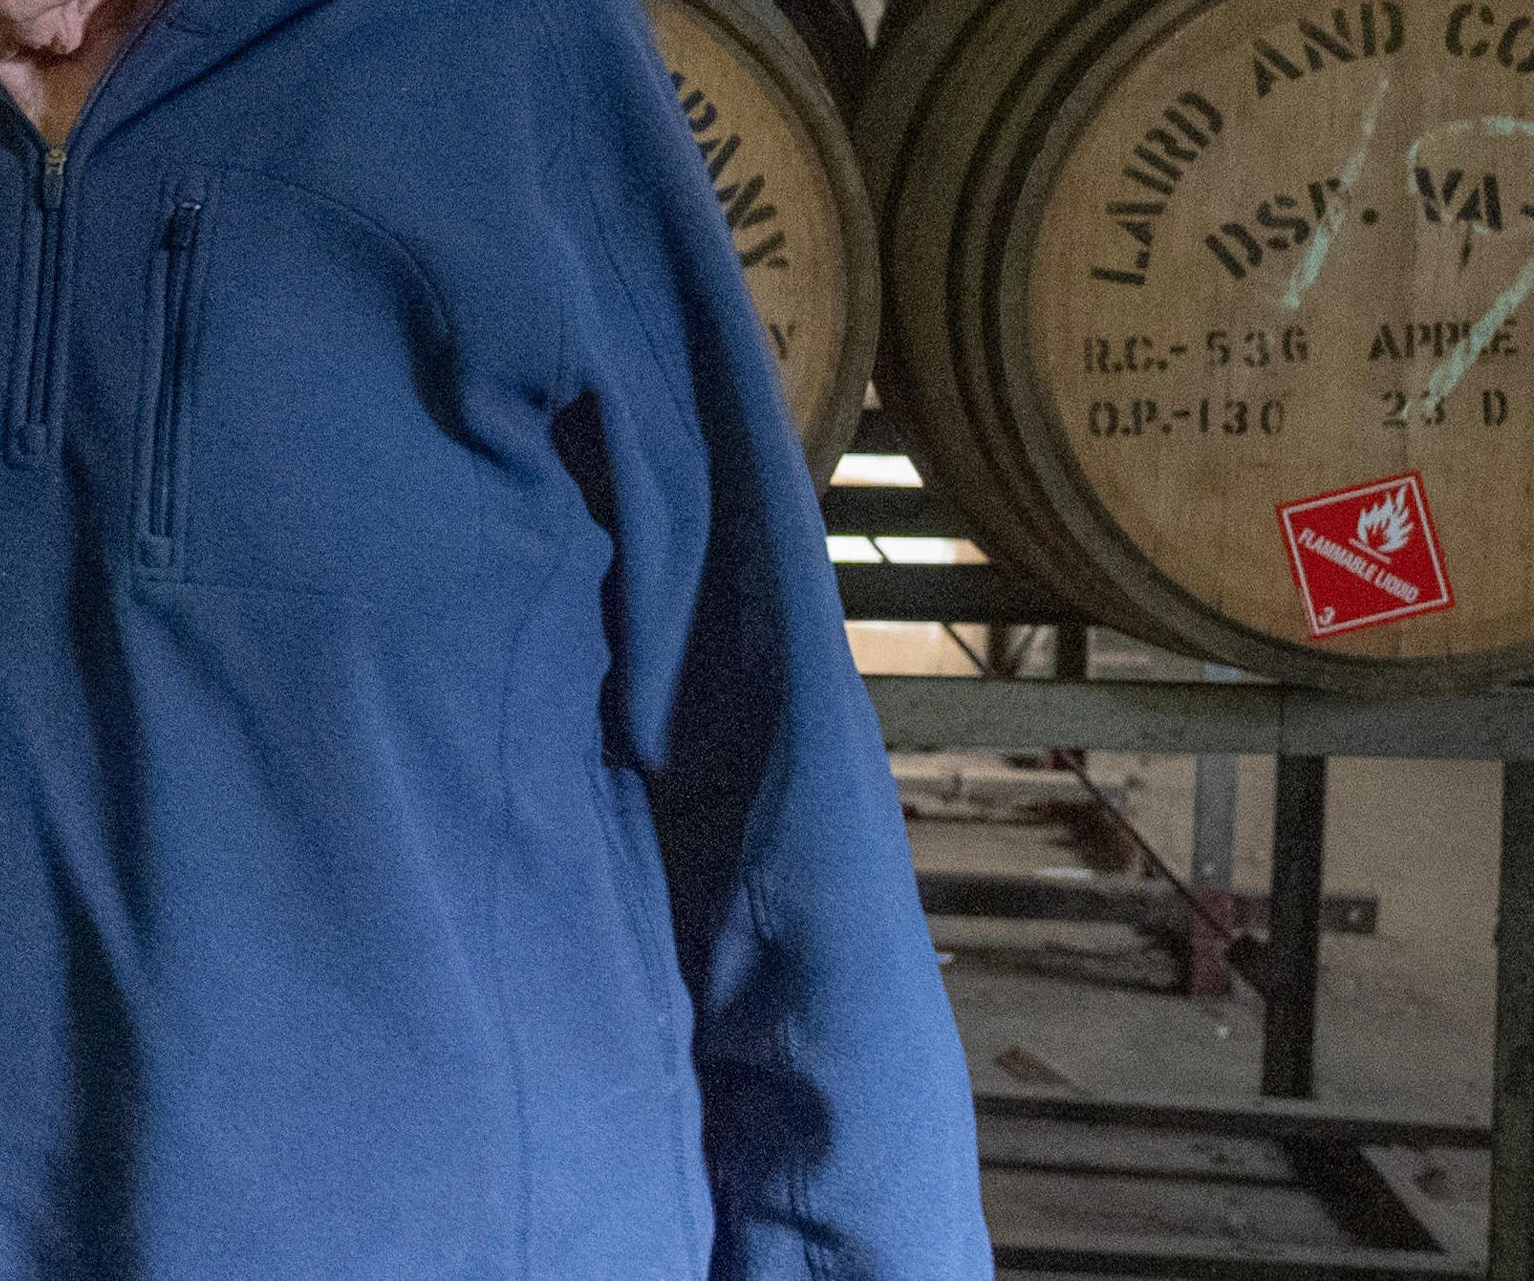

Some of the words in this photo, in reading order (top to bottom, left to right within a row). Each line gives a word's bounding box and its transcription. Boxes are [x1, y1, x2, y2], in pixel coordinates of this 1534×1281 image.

[1090, 91, 1224, 287] LAIRD
[1252, 1, 1406, 100] AND
[1482, 388, 1509, 427] D
[1297, 527, 1379, 581] FLAMMABLE
[1373, 569, 1421, 605] LIQUID
